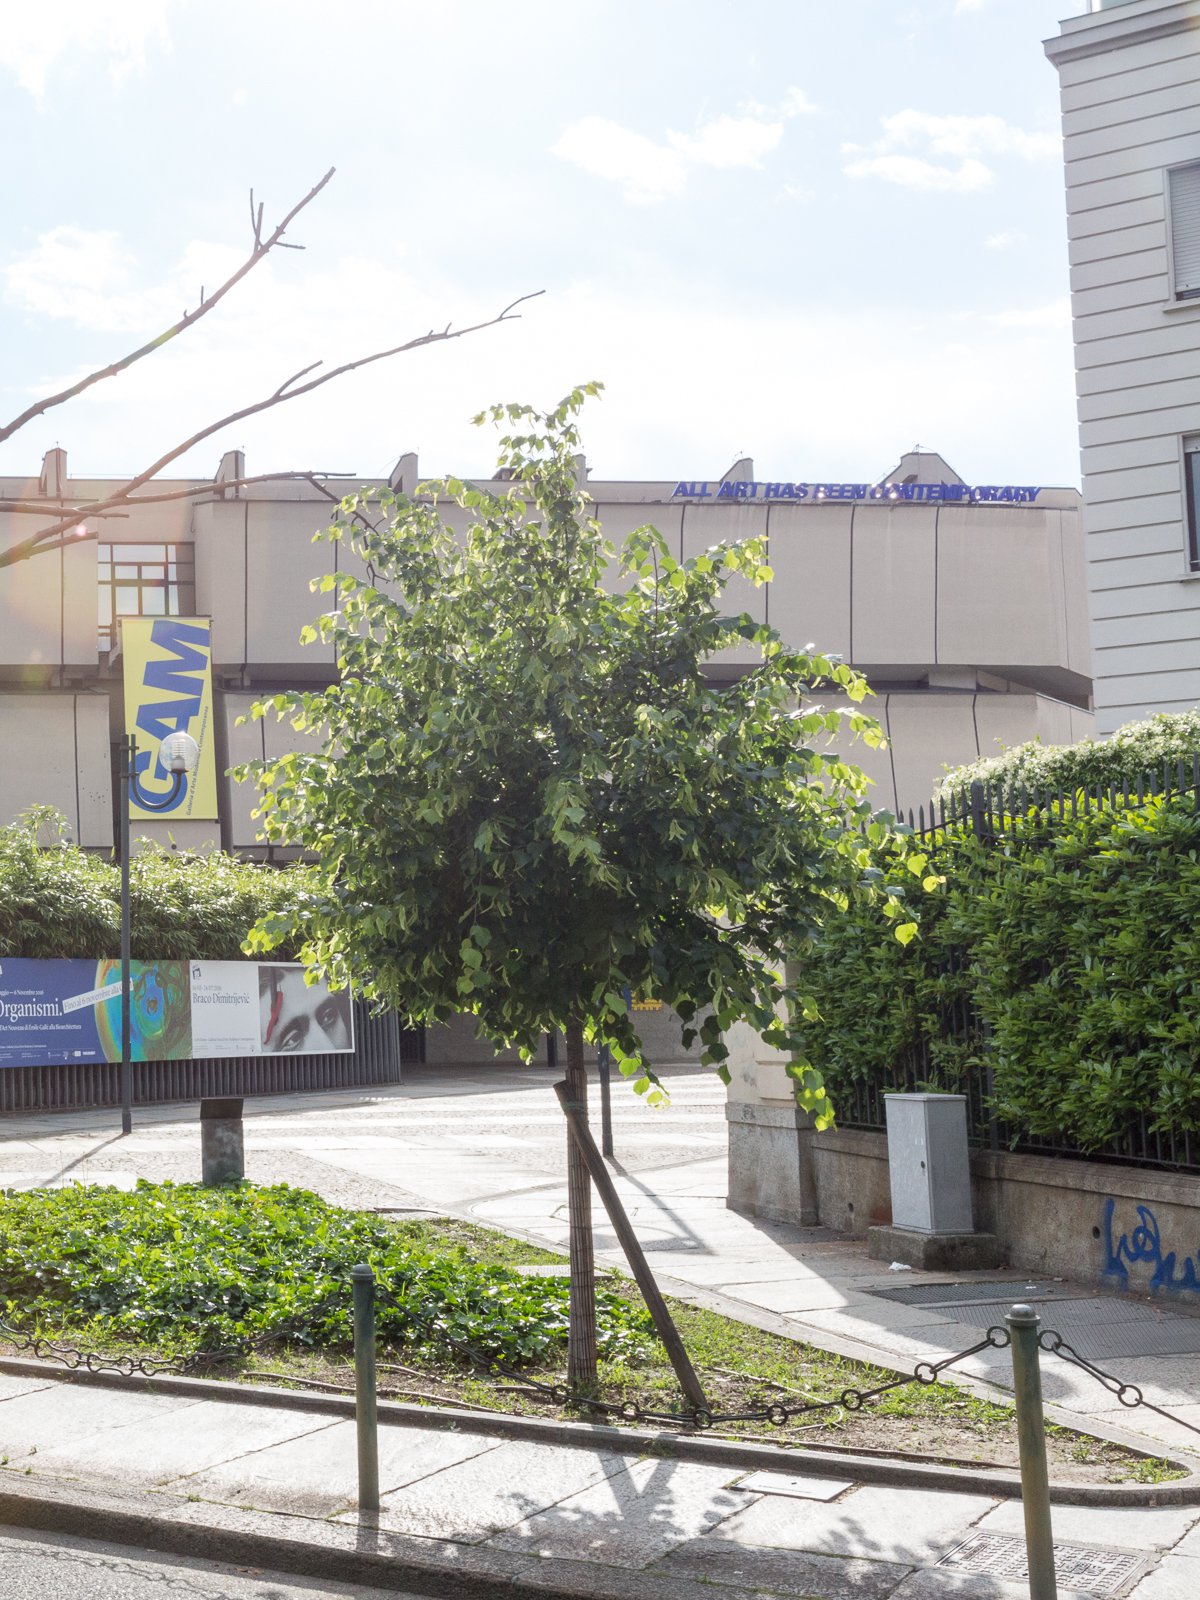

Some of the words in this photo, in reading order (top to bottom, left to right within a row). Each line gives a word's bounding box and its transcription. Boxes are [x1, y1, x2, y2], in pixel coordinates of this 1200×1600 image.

[672, 480, 712, 497] ALL
[717, 480, 760, 498] ART
[764, 481, 809, 499] HAS
[812, 482, 867, 500] BEEN
[870, 482, 1041, 503] CONTEMPORARY
[128, 620, 210, 813] GAM
[193, 992, 212, 1004] Braco
